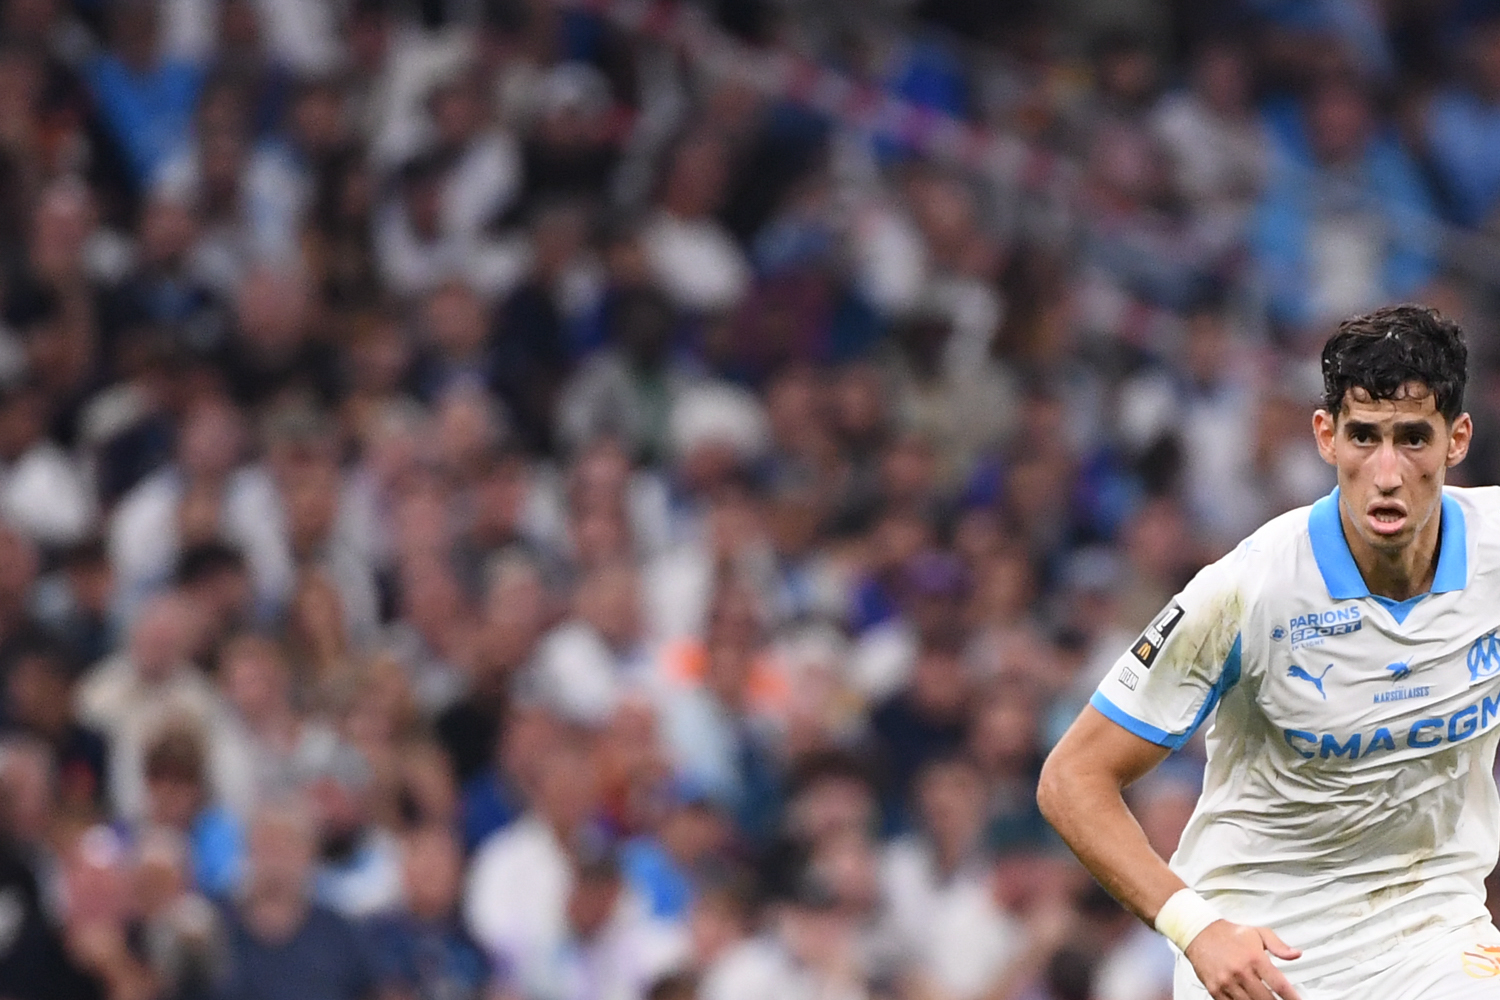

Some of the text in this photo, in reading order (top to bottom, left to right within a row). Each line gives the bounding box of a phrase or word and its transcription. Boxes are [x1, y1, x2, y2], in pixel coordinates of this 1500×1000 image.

[1290, 606, 1361, 631] PARIONS
[1292, 620, 1361, 643] SPORT
[1284, 728, 1396, 759] CMA
